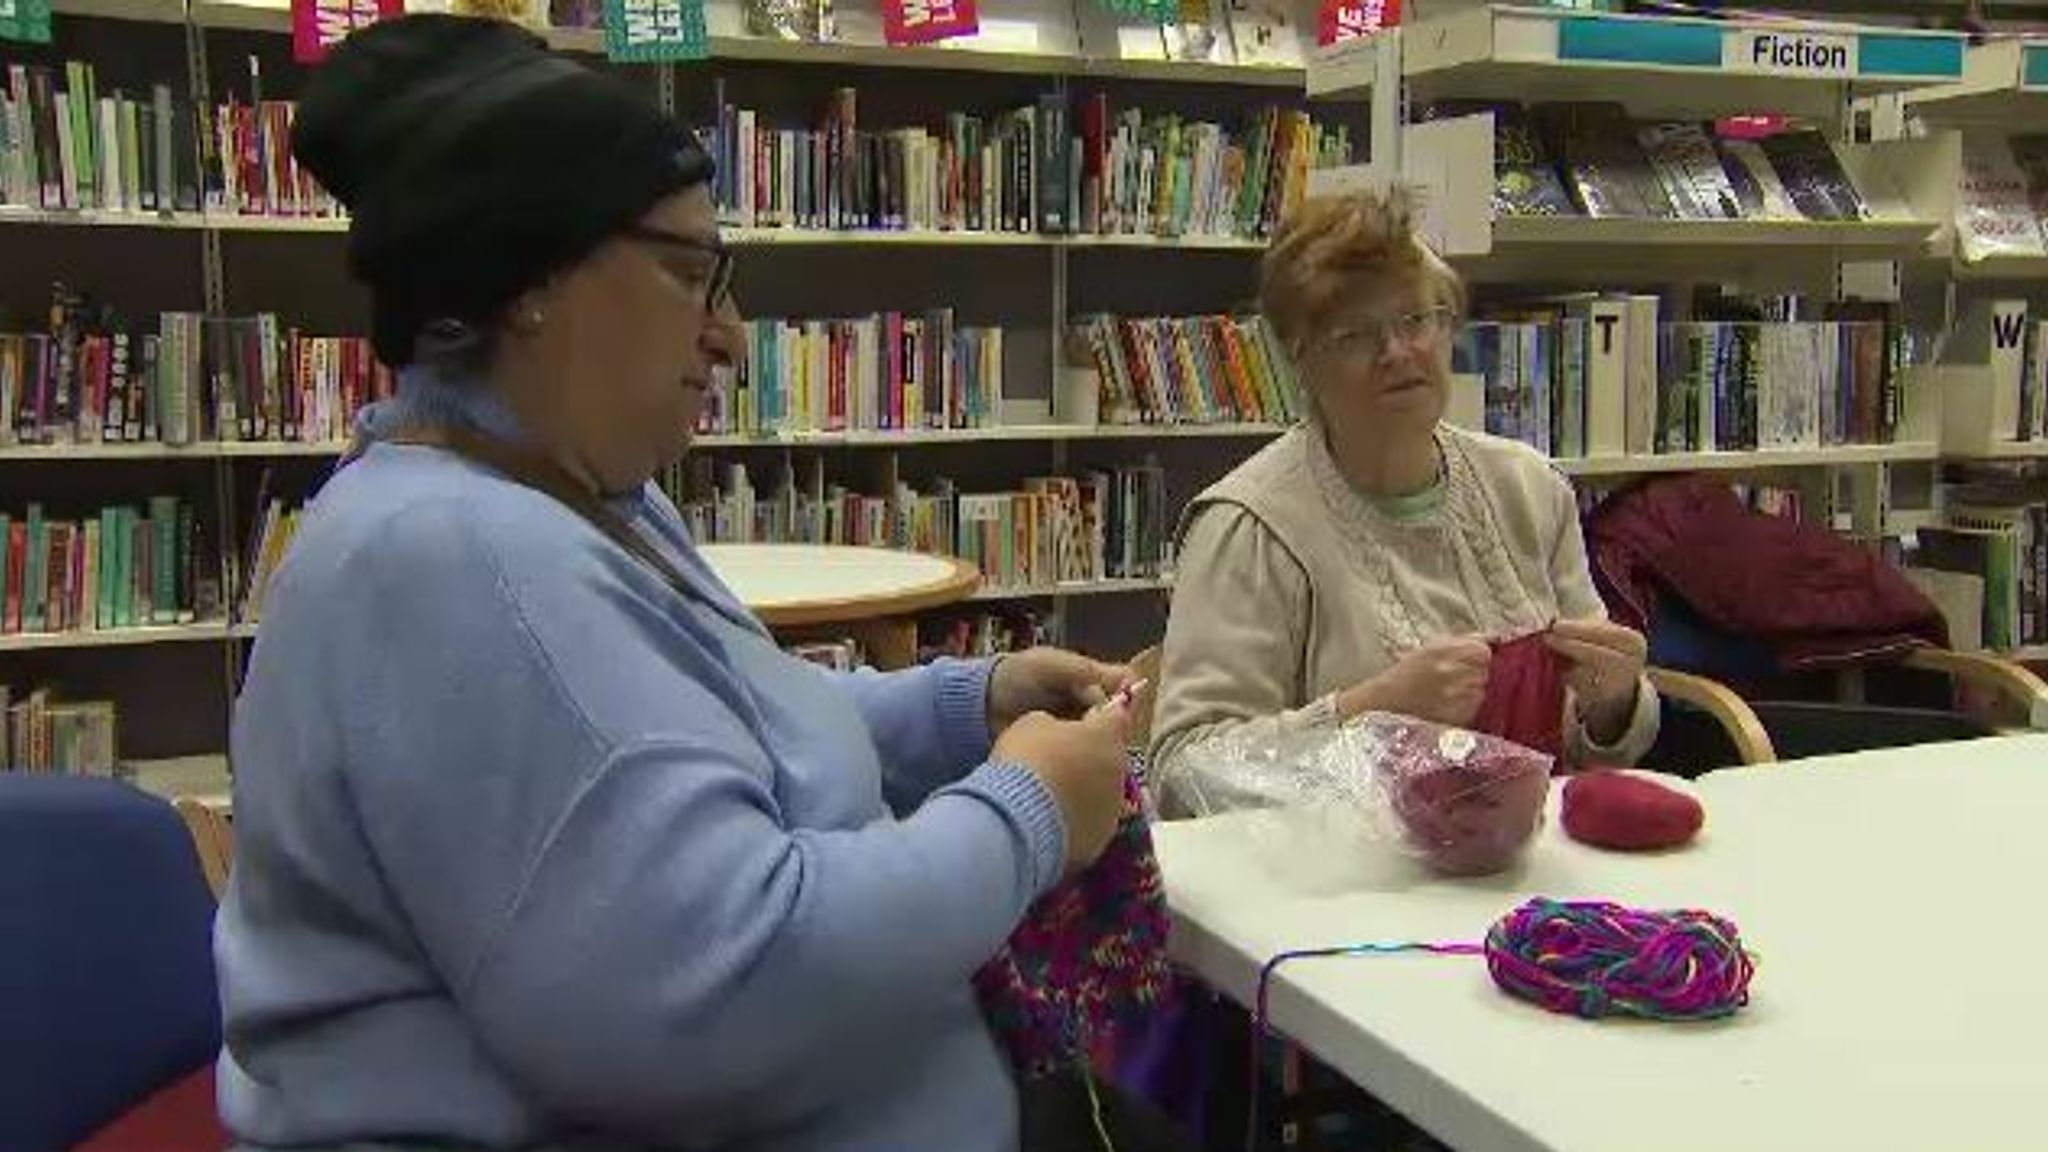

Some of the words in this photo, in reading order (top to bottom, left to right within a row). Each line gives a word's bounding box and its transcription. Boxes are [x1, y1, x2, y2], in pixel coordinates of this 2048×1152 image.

[1753, 34, 1847, 69] Fiction
[1594, 315, 1618, 354] T
[1993, 313, 2025, 349] W
